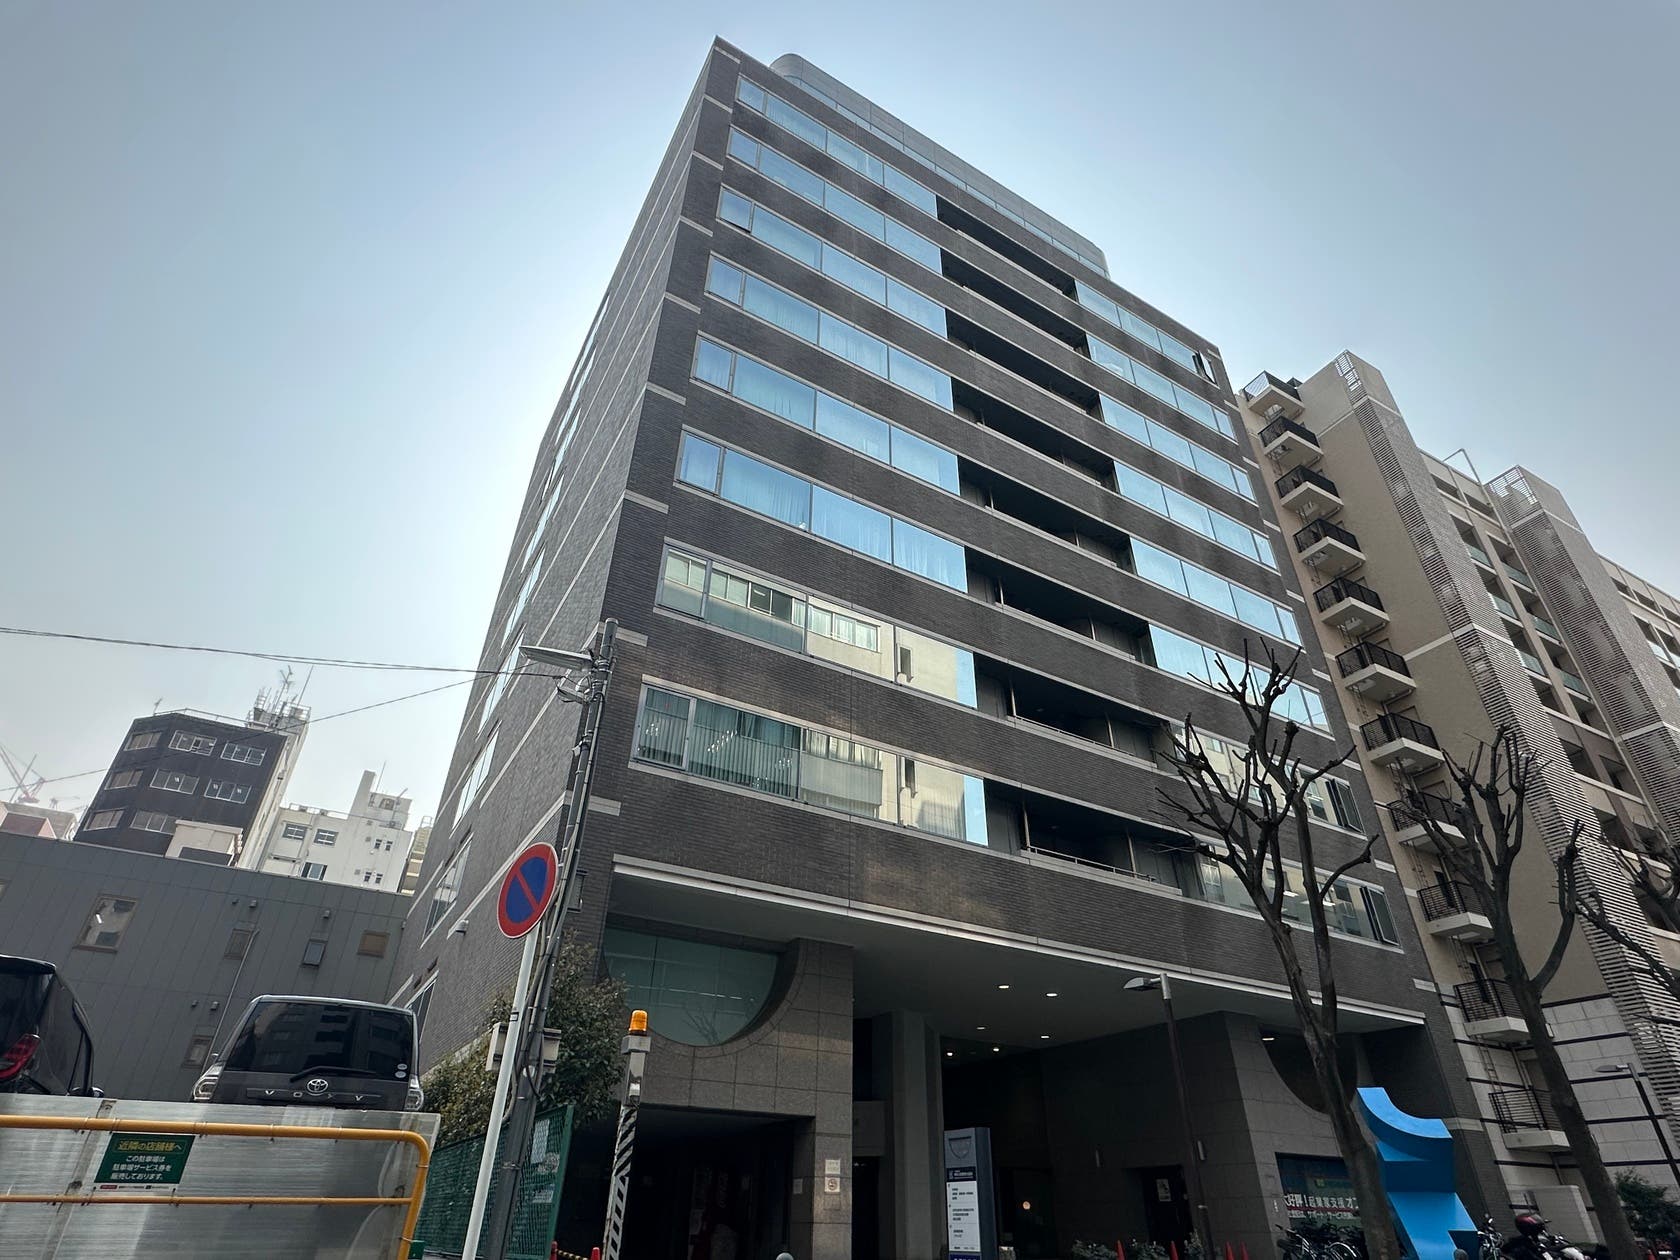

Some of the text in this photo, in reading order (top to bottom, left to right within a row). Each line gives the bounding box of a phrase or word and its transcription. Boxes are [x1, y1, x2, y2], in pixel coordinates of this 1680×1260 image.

[126, 1155, 166, 1163] この駐車場は
